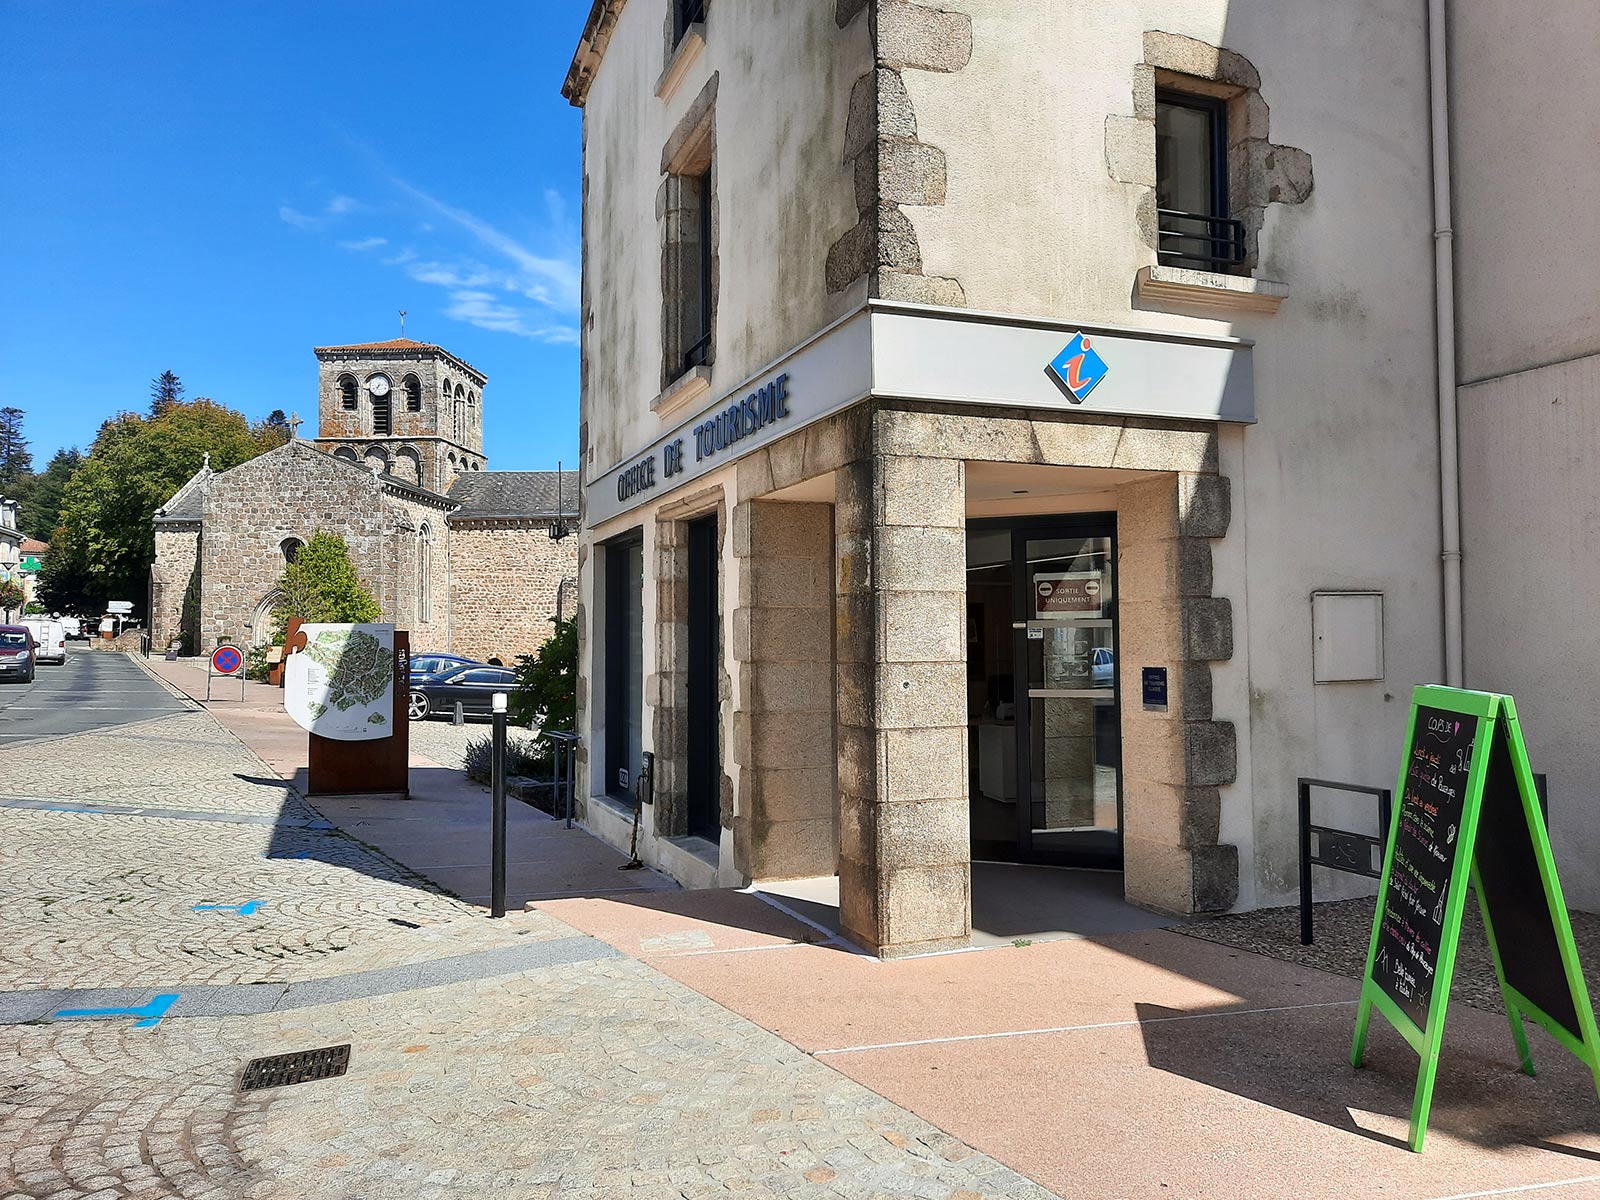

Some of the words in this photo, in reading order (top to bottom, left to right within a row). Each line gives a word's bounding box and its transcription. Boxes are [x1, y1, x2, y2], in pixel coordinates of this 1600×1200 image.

[617, 455, 656, 502] OFFICE
[664, 438, 684, 479] DE
[693, 373, 790, 463] TOURISME
[1055, 587, 1080, 595] SORTIE
